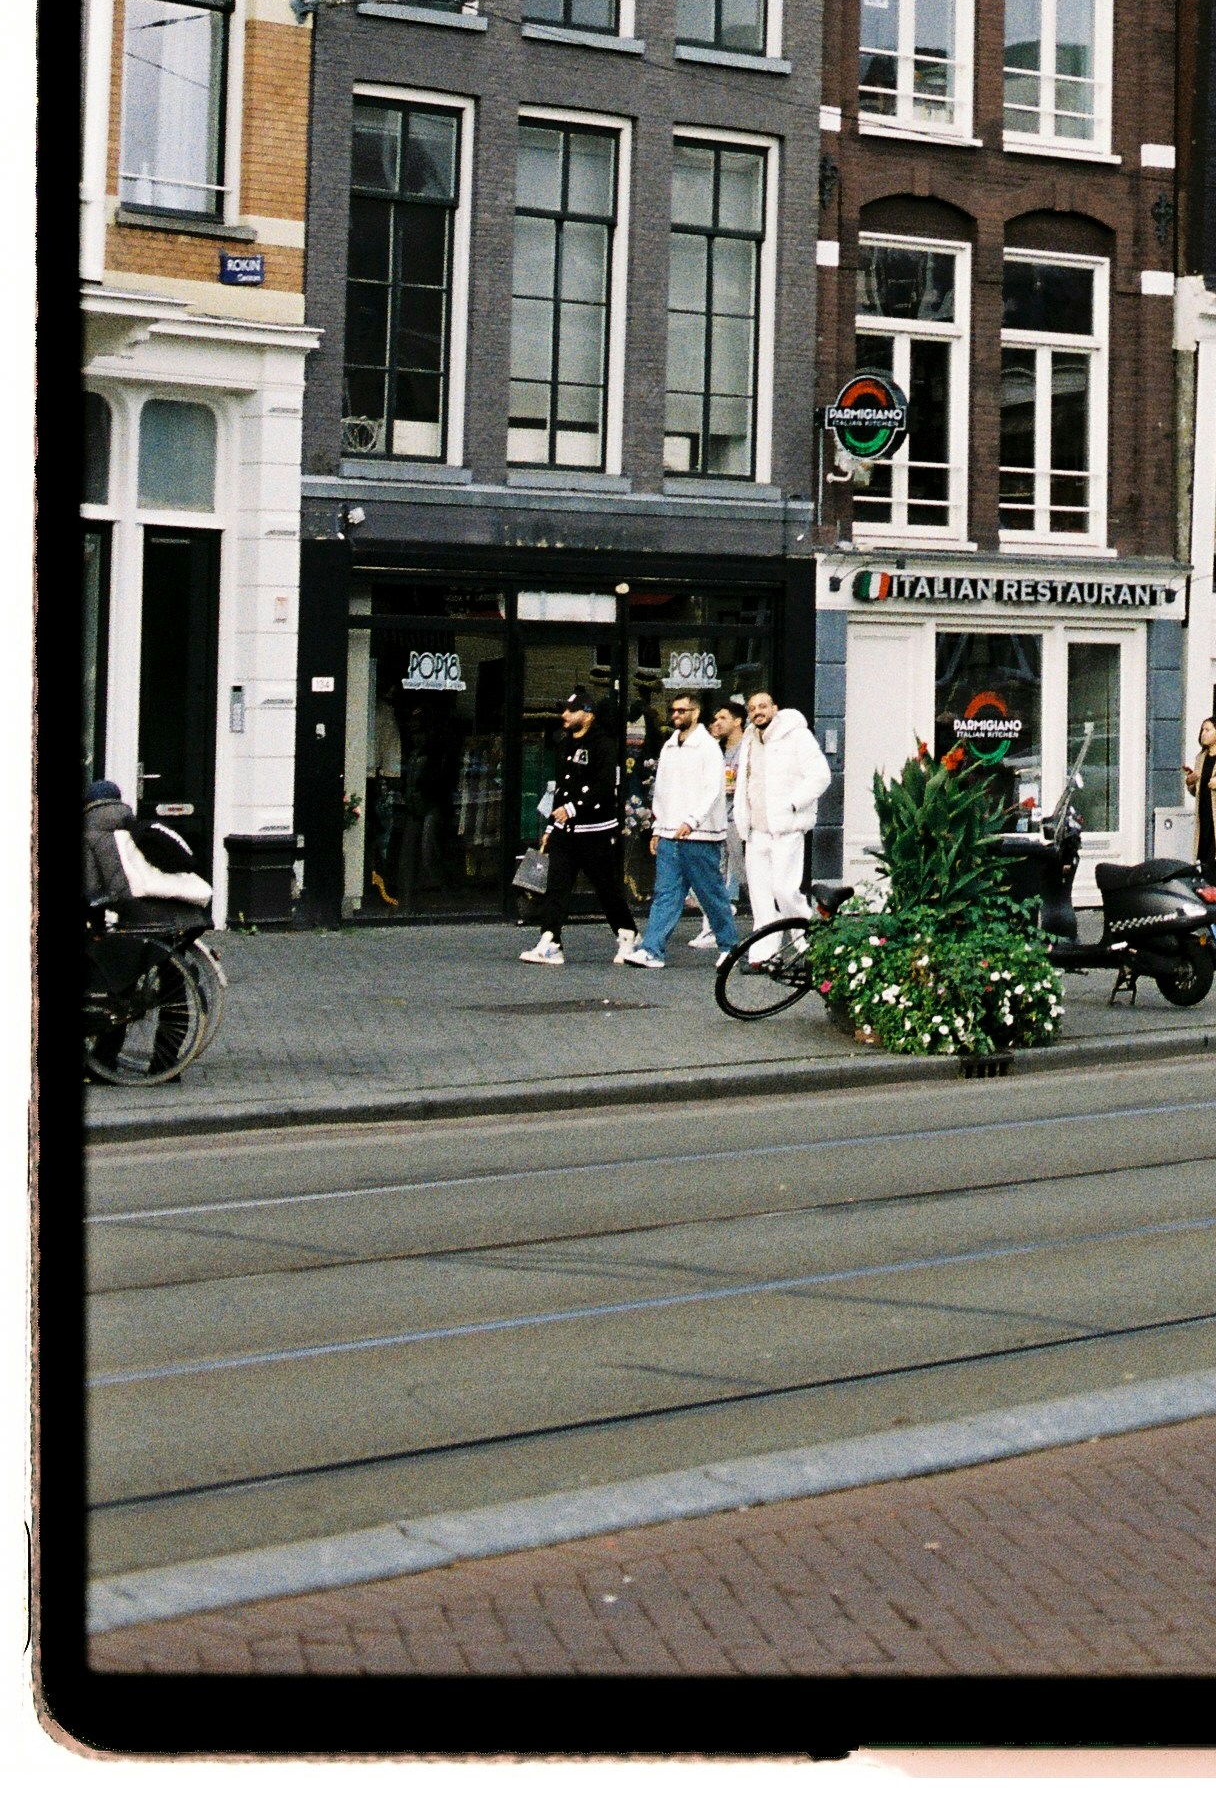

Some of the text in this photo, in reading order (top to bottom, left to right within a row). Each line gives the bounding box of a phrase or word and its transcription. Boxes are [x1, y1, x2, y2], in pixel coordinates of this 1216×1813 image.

[227, 258, 261, 272] ROKIN
[829, 408, 903, 420] PARMIGIANO
[832, 419, 863, 427] ITALIAN
[891, 574, 1165, 606] ITALIAN RESTAURANT
[408, 650, 461, 681] POP18
[669, 651, 717, 680] POP18
[953, 718, 1023, 731] PARMIGIANO
[957, 731, 1020, 739] ITALIAN KITCHEN
